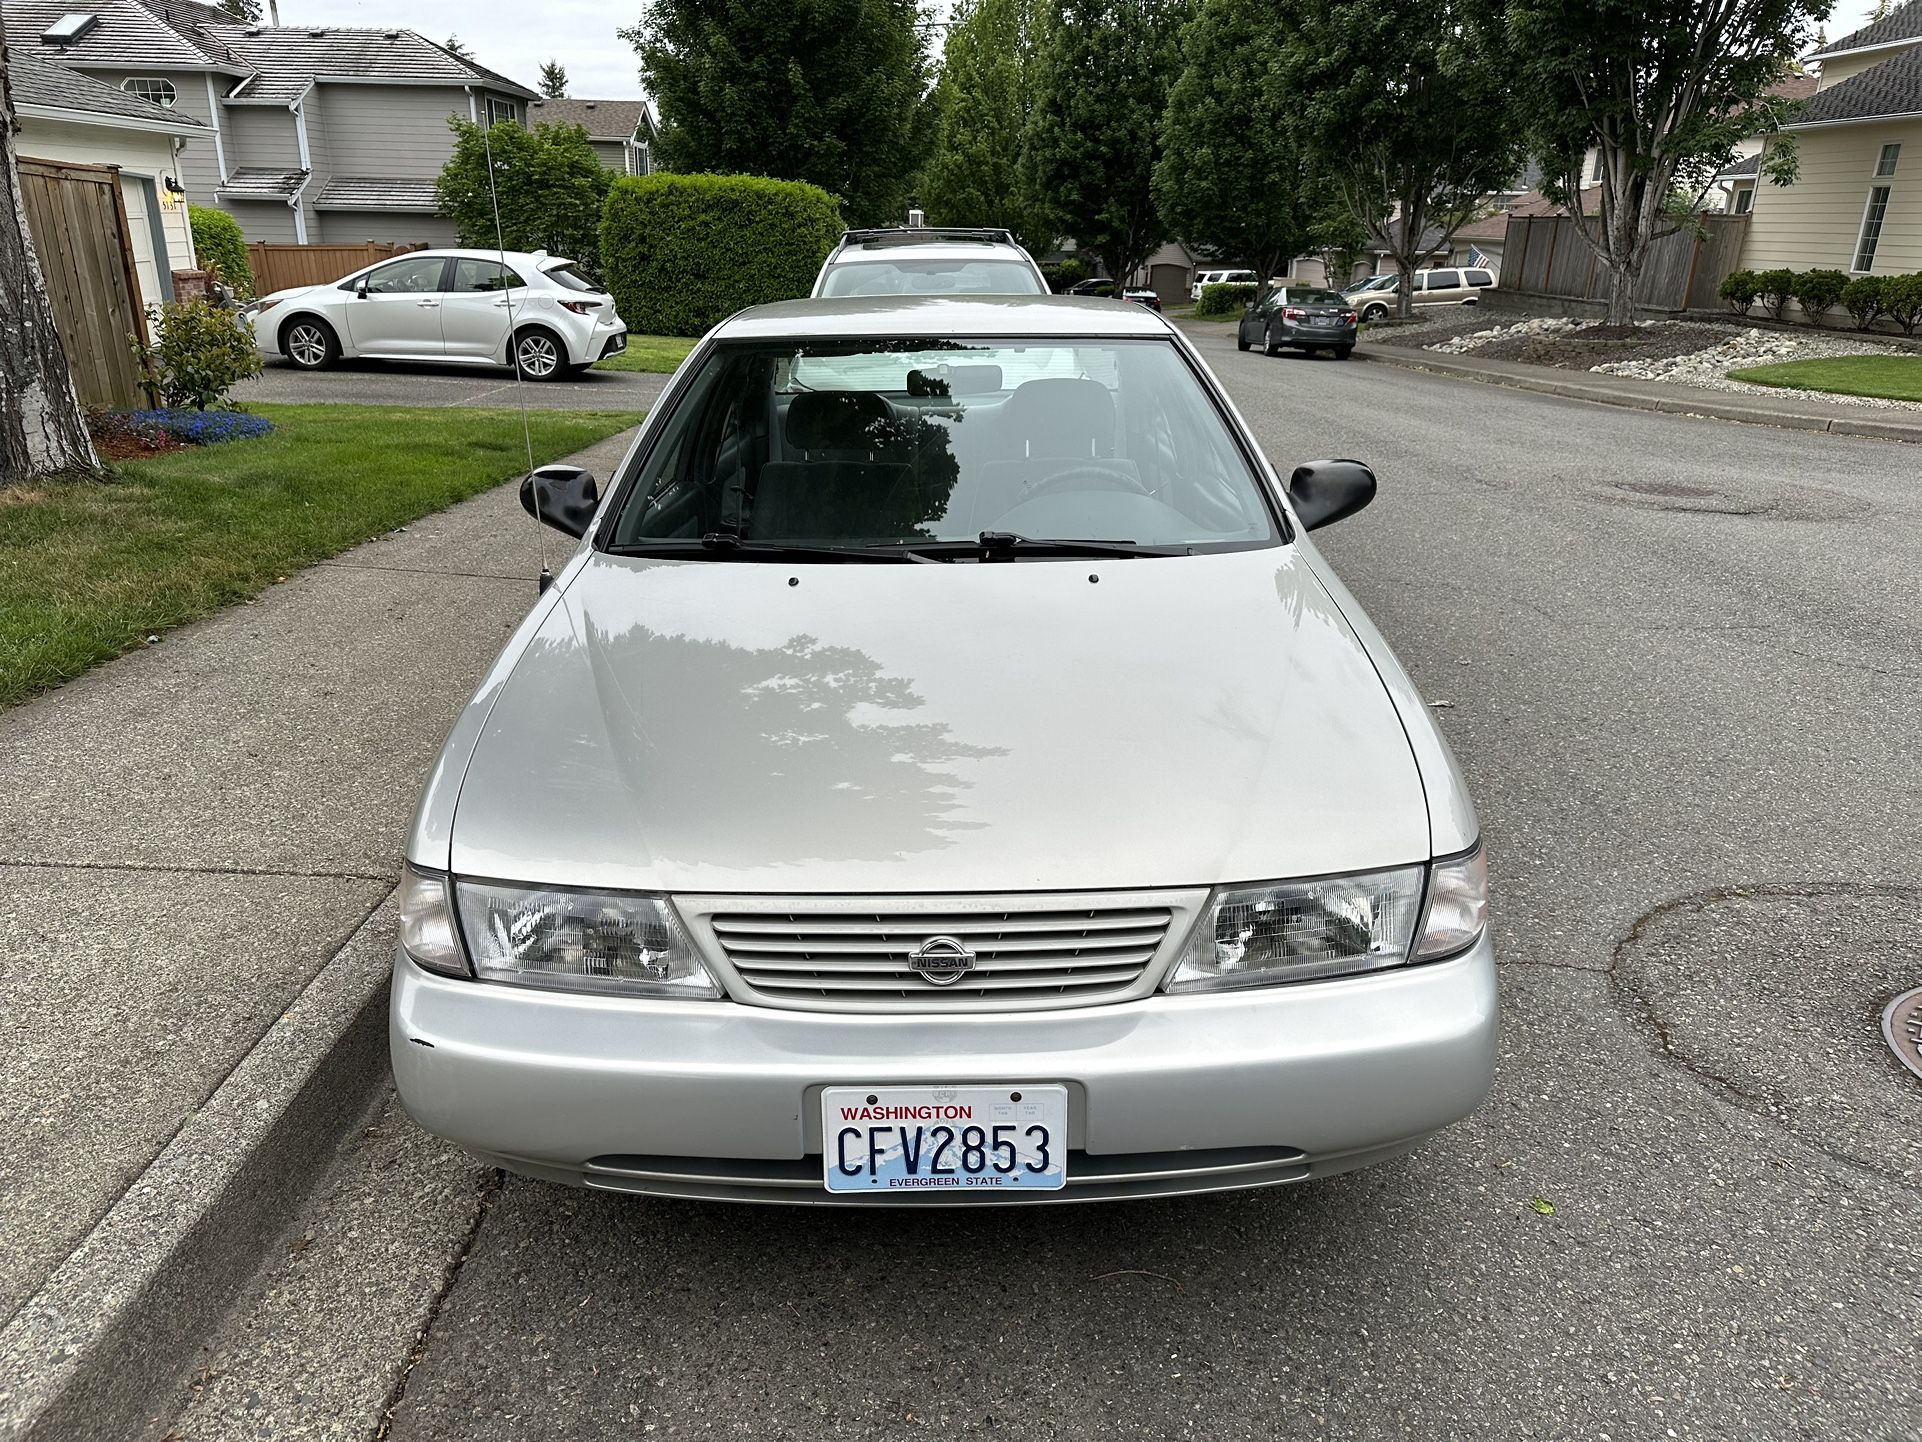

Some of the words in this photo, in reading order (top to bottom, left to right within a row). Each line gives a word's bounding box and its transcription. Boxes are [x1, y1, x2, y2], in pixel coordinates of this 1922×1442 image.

[916, 958, 968, 968] NISSAN
[840, 1105, 972, 1121] WASHINGTON
[837, 1125, 1050, 1176] CFV2853
[889, 1177, 960, 1187] EVERGREEN
[965, 1176, 1003, 1186] STATE
